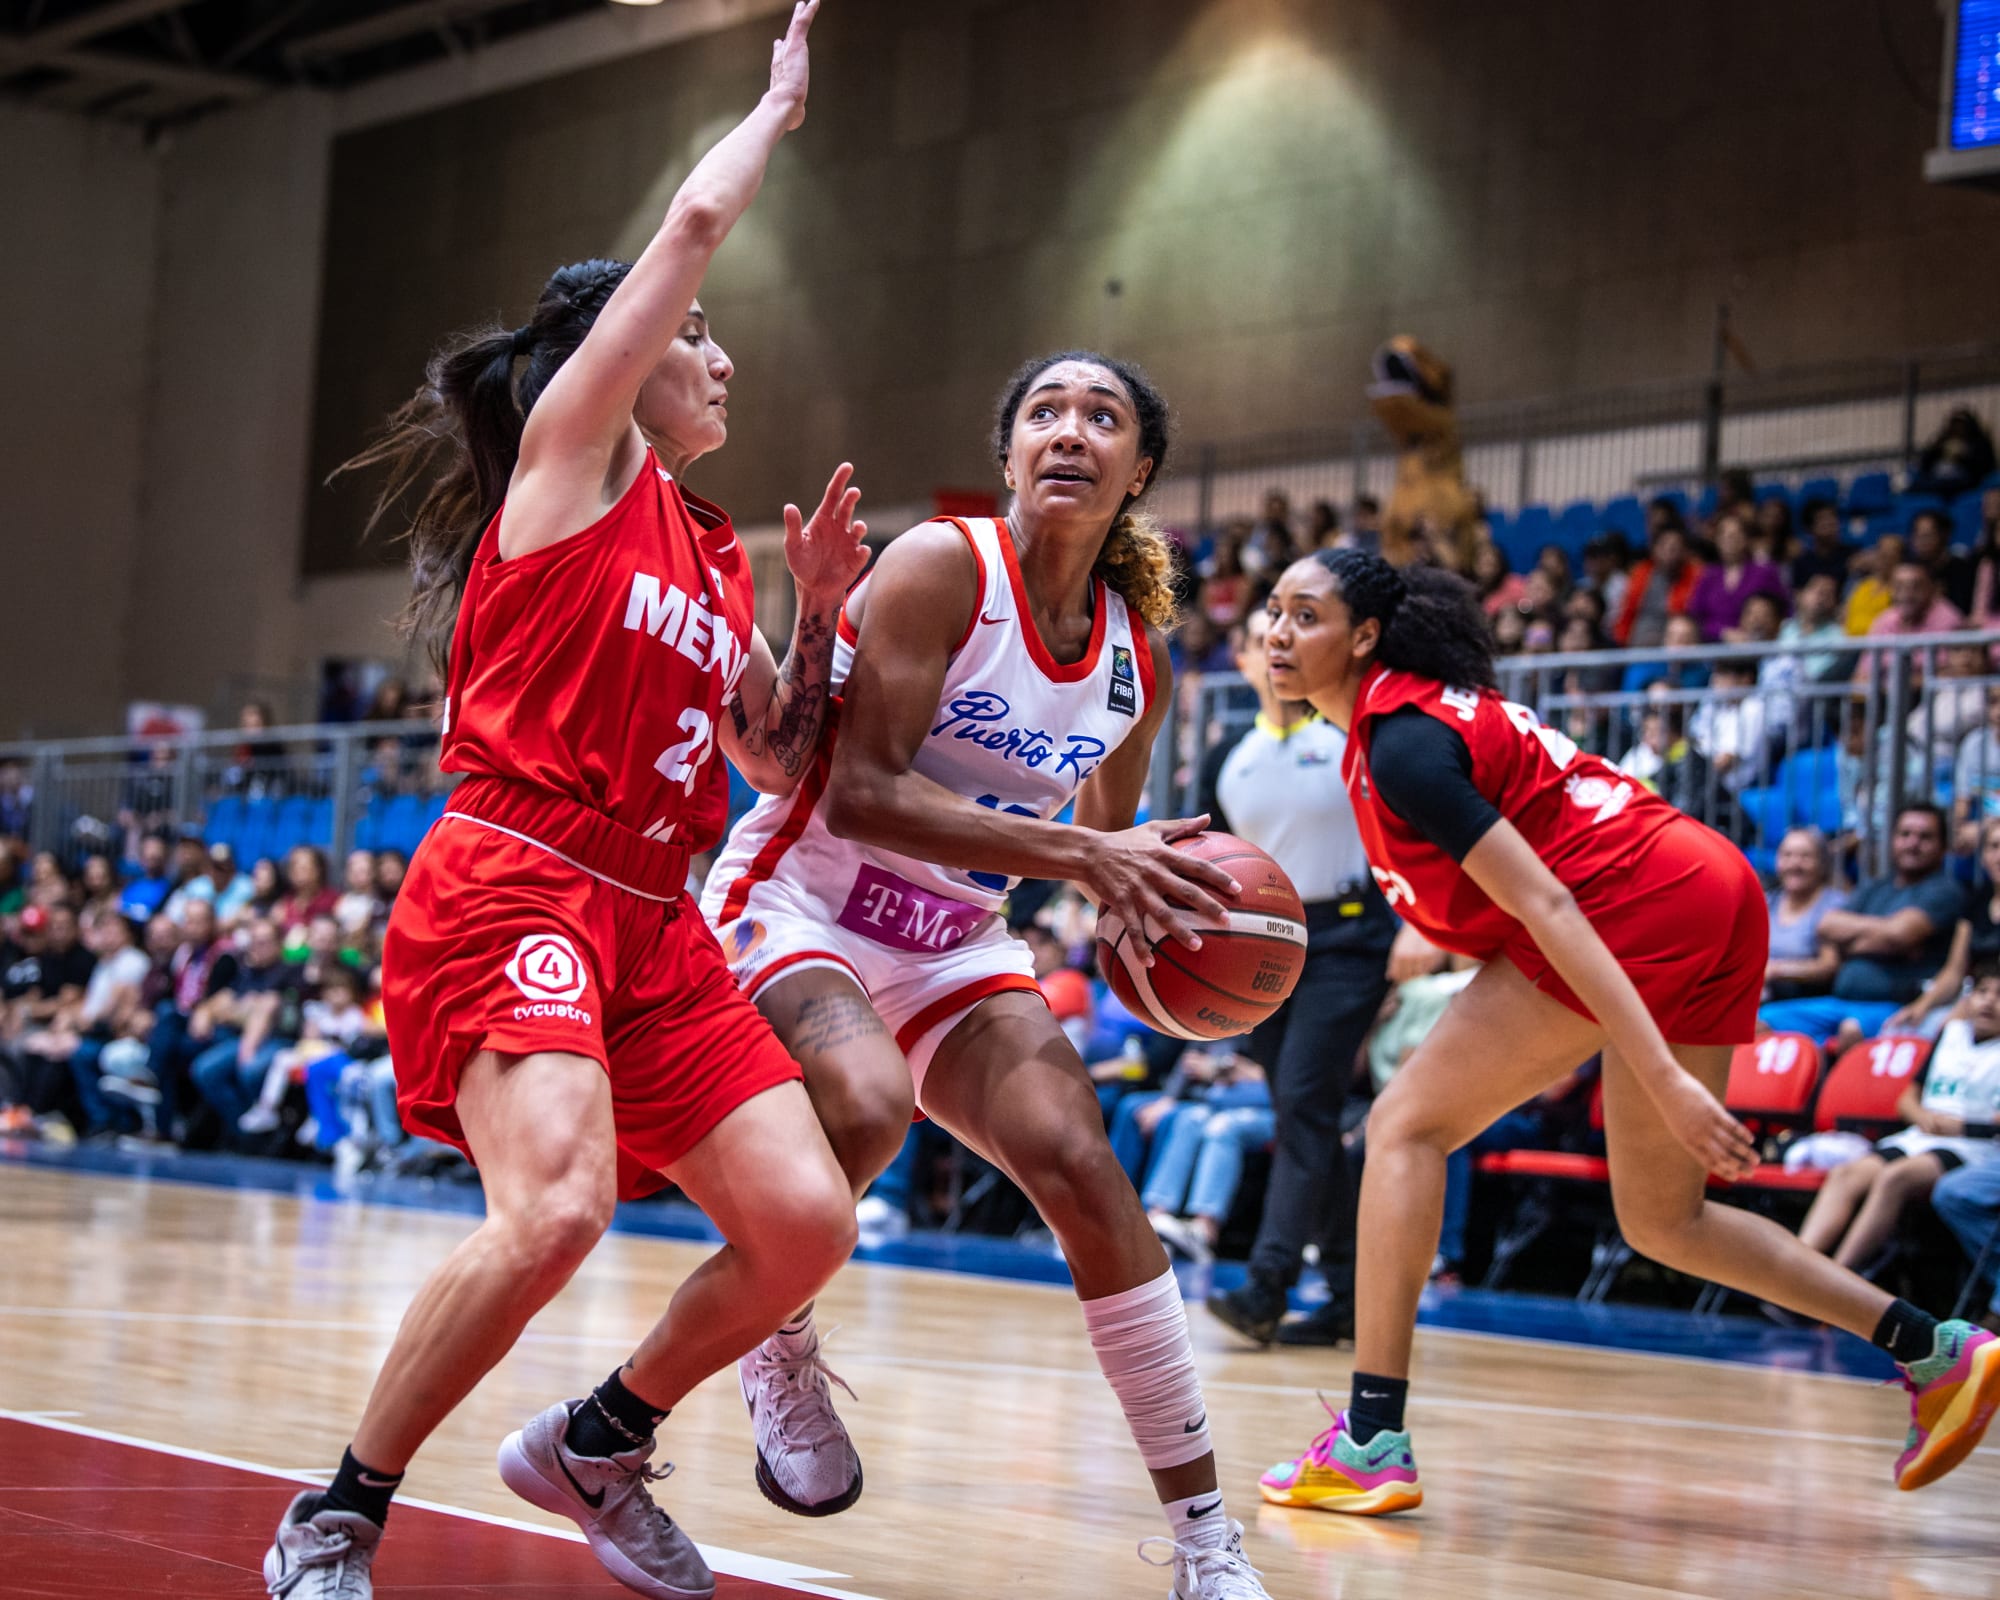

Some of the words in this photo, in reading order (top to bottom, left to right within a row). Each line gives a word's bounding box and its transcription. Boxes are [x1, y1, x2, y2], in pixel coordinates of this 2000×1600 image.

[1113, 682, 1133, 700] FIBA
[931, 690, 1053, 768] Puerto
[538, 952, 562, 979] 4
[1252, 972, 1287, 994] FIBA
[513, 1003, 591, 1025] tvcuatro
[1755, 1037, 1799, 1074] 19
